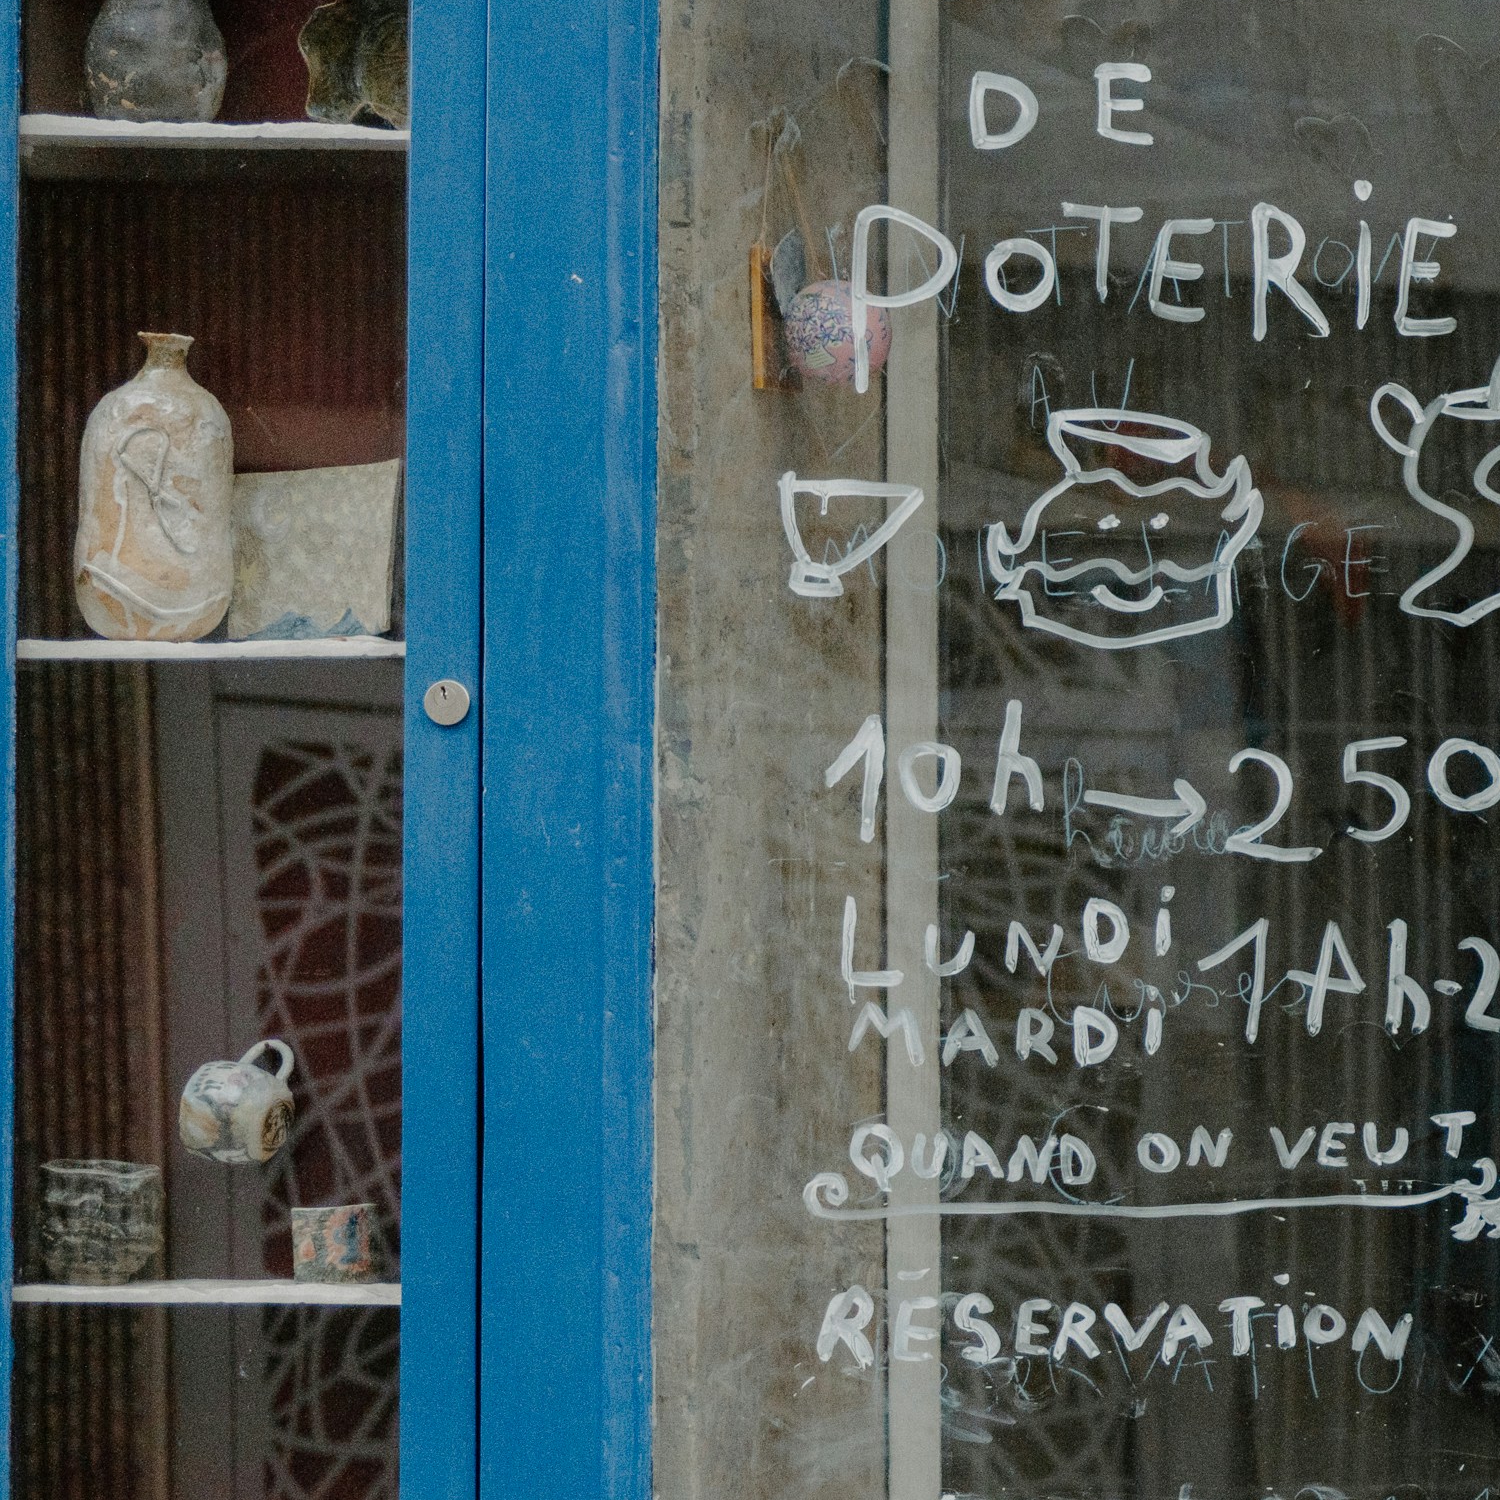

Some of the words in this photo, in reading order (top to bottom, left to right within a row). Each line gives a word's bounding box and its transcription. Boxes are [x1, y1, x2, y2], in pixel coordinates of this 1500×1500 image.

[970, 63, 1153, 150] DE
[852, 179, 1459, 393] POTERIE
[825, 700, 1044, 843] 10h
[842, 886, 1176, 1005] LUNDI
[849, 985, 1162, 1068] MARDI
[850, 1122, 1097, 1192] QUAND
[1138, 1127, 1233, 1176] ON
